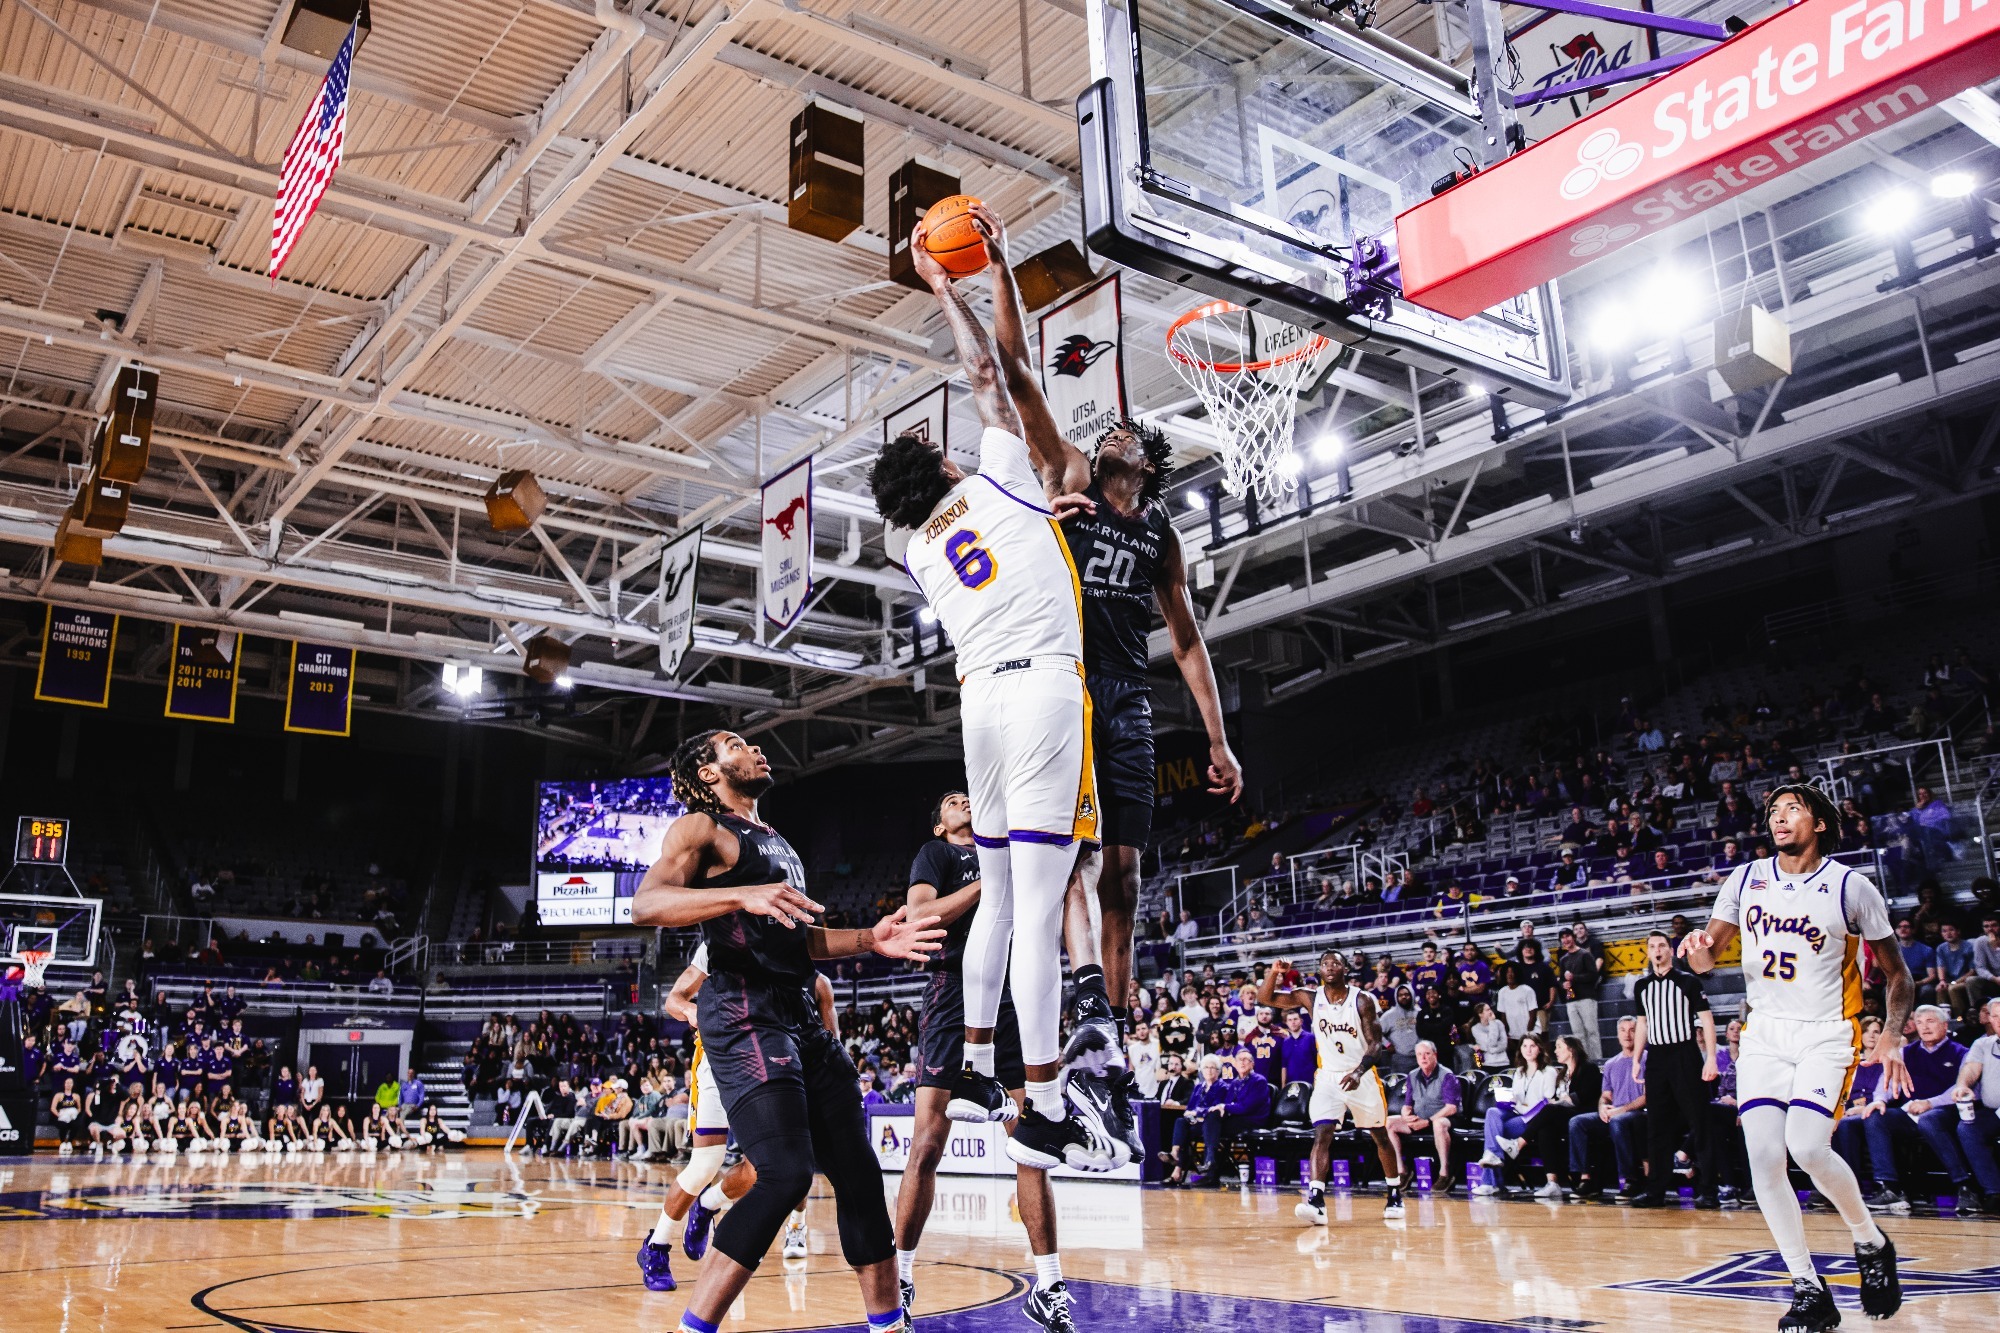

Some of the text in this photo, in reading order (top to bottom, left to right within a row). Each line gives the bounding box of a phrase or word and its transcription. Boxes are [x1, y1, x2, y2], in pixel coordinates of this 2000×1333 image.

[1652, 0, 1989, 159] State Far
[1632, 83, 1930, 225] State Farm
[1073, 400, 1096, 423] UTSA
[925, 496, 970, 544] JOHNSON
[779, 557, 793, 574] SMU
[944, 528, 999, 591] 6
[1083, 540, 1137, 590] 20
[771, 568, 800, 593] MUSTANGS
[74, 615, 91, 625] CAA
[54, 622, 109, 637] TOURNAMENT
[52, 632, 108, 648] CHAMPIONS
[67, 648, 91, 661] 1993
[316, 653, 332, 664] CIT
[179, 665, 231, 679] 2011 2013
[298, 663, 348, 677] CHAMPIONS
[177, 677, 202, 688] 2014
[310, 682, 334, 693] 2013
[31, 821, 62, 837] 8:35
[553, 885, 598, 896] Pizza Hut
[572, 907, 611, 916] HEALTH
[1746, 905, 1827, 955] Pirates
[1763, 950, 1798, 982] 25
[1319, 1018, 1358, 1039] Pirates
[1335, 1041, 1344, 1053] 3
[951, 1138, 986, 1157] CLUB
